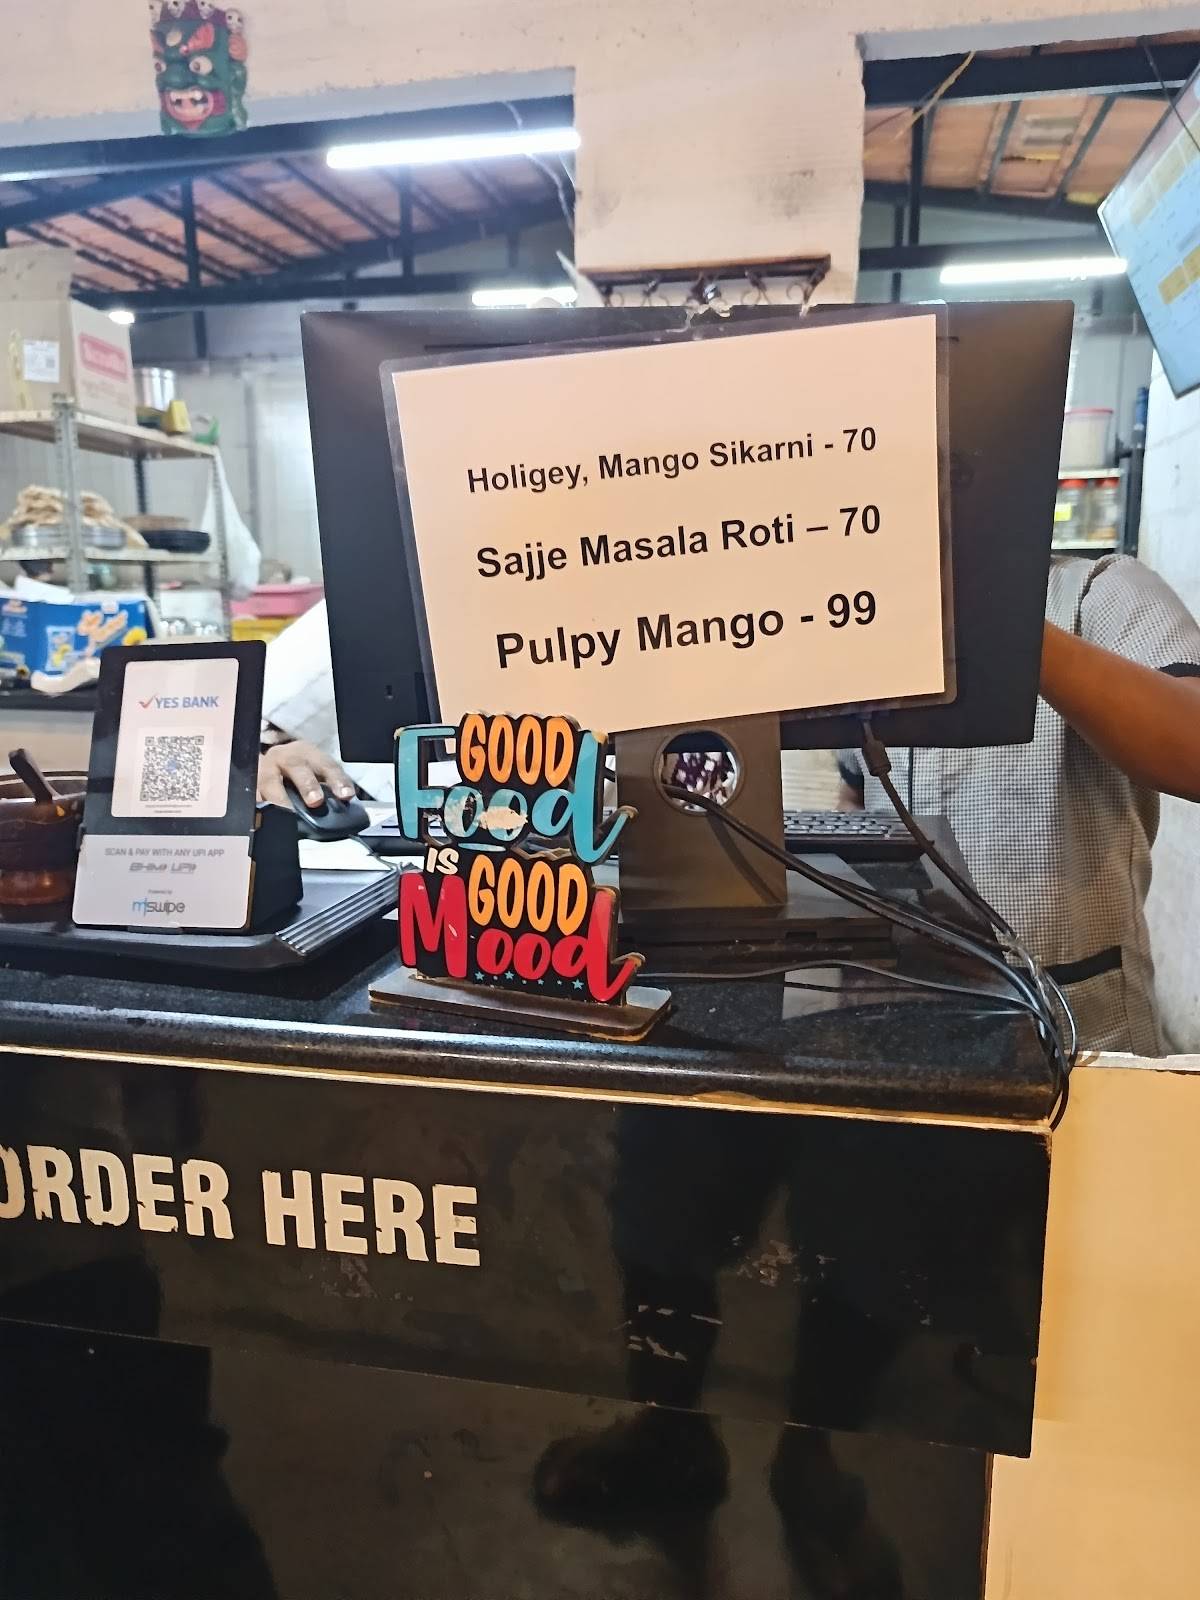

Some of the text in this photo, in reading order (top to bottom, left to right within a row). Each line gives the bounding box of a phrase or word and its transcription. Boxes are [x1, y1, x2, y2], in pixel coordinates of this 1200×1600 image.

[467, 464, 589, 494] Holigey,
[598, 452, 700, 480] Mango
[709, 433, 814, 468] Sikarni
[842, 426, 877, 453] 70
[476, 541, 568, 582] Sajje
[579, 525, 709, 567] Masala
[721, 513, 795, 550] Roti
[839, 504, 881, 537] 70
[495, 626, 622, 669] Pulpy
[637, 610, 785, 652] Mango
[827, 590, 878, 629] 99
[154, 696, 219, 709] YES BANK
[460, 713, 574, 787] GOOD
[152, 848, 173, 856] WITH
[174, 848, 191, 857] ANY
[207, 848, 225, 857] APP
[468, 854, 588, 936] GOOD
[400, 871, 637, 1001] Mood
[261, 1169, 481, 1267] HERE
